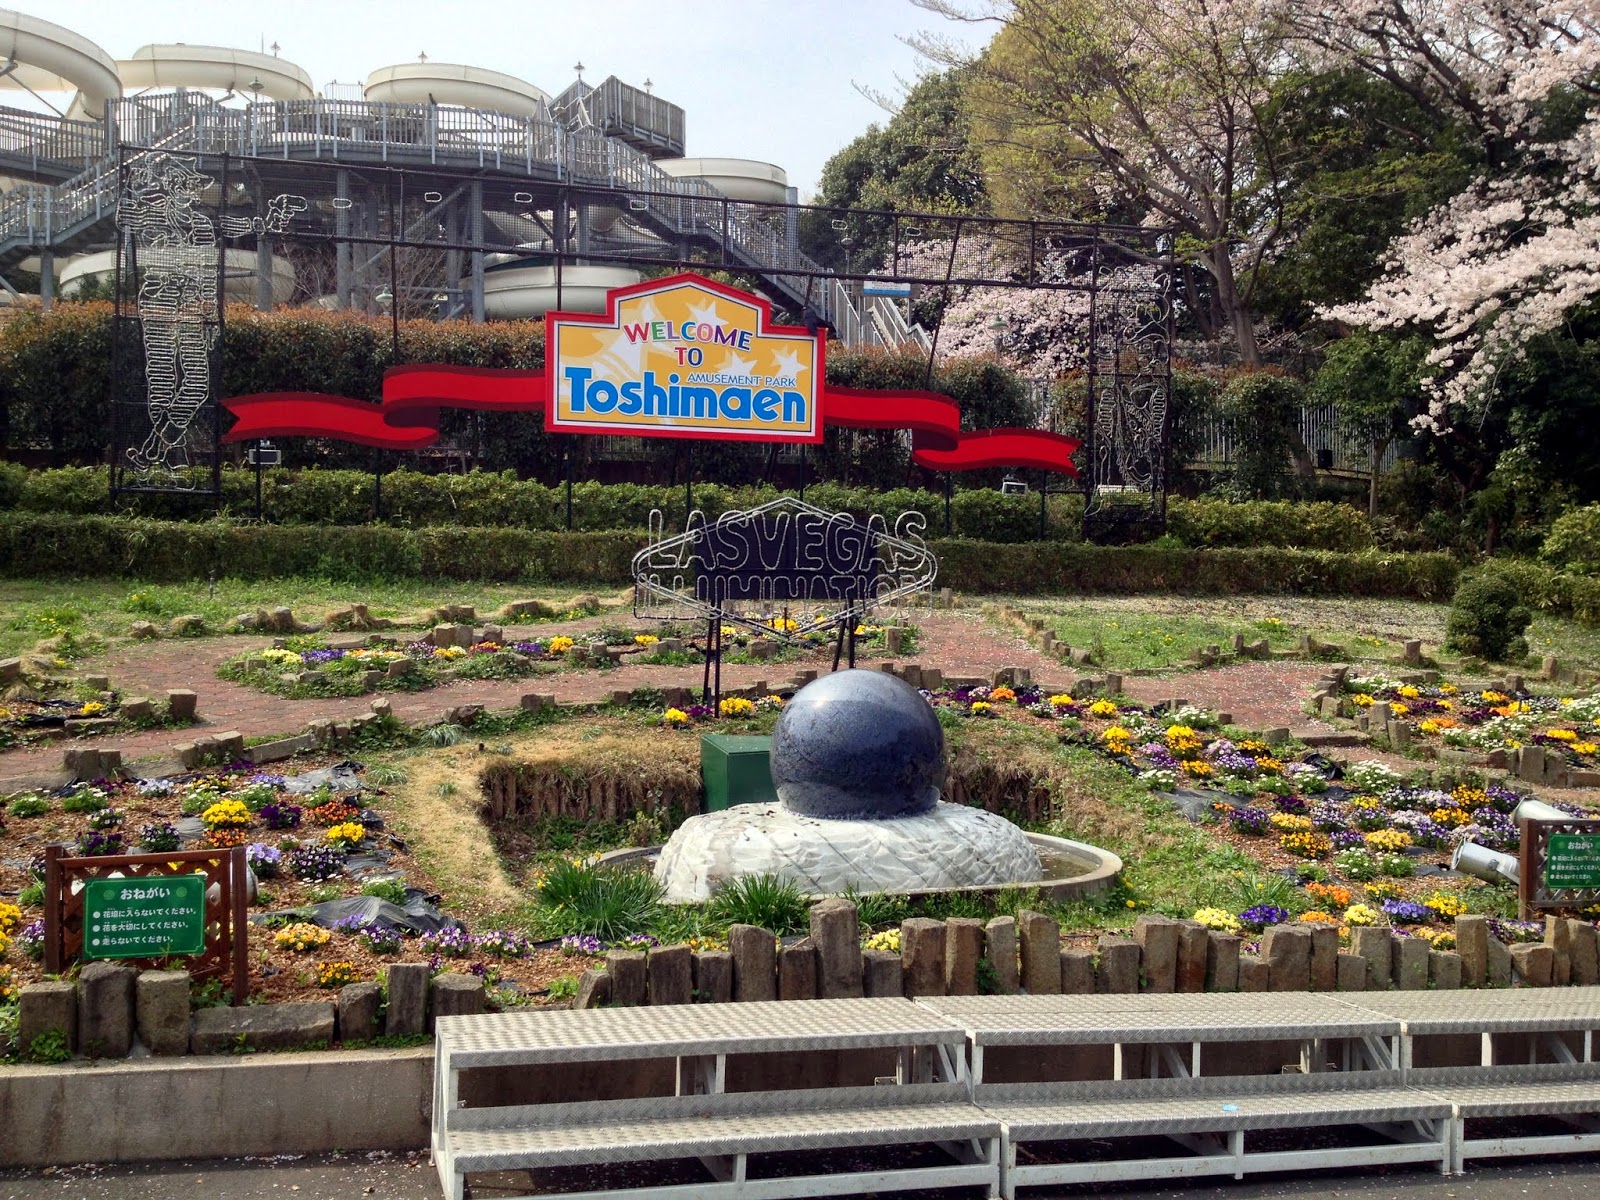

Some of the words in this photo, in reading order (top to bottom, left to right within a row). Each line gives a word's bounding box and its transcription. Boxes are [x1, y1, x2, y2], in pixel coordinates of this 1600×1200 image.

[624, 321, 753, 350] WELCOME
[675, 346, 703, 366] TO
[687, 373, 761, 386] AMUSEMENT
[765, 377, 797, 388] PARK
[565, 366, 806, 423] Toshimaen
[120, 887, 171, 899] おねがい
[103, 907, 196, 918] 花壇に入らないでください。
[102, 922, 188, 932] 花を大切にしてください。
[102, 935, 173, 945] 走らないでください。
